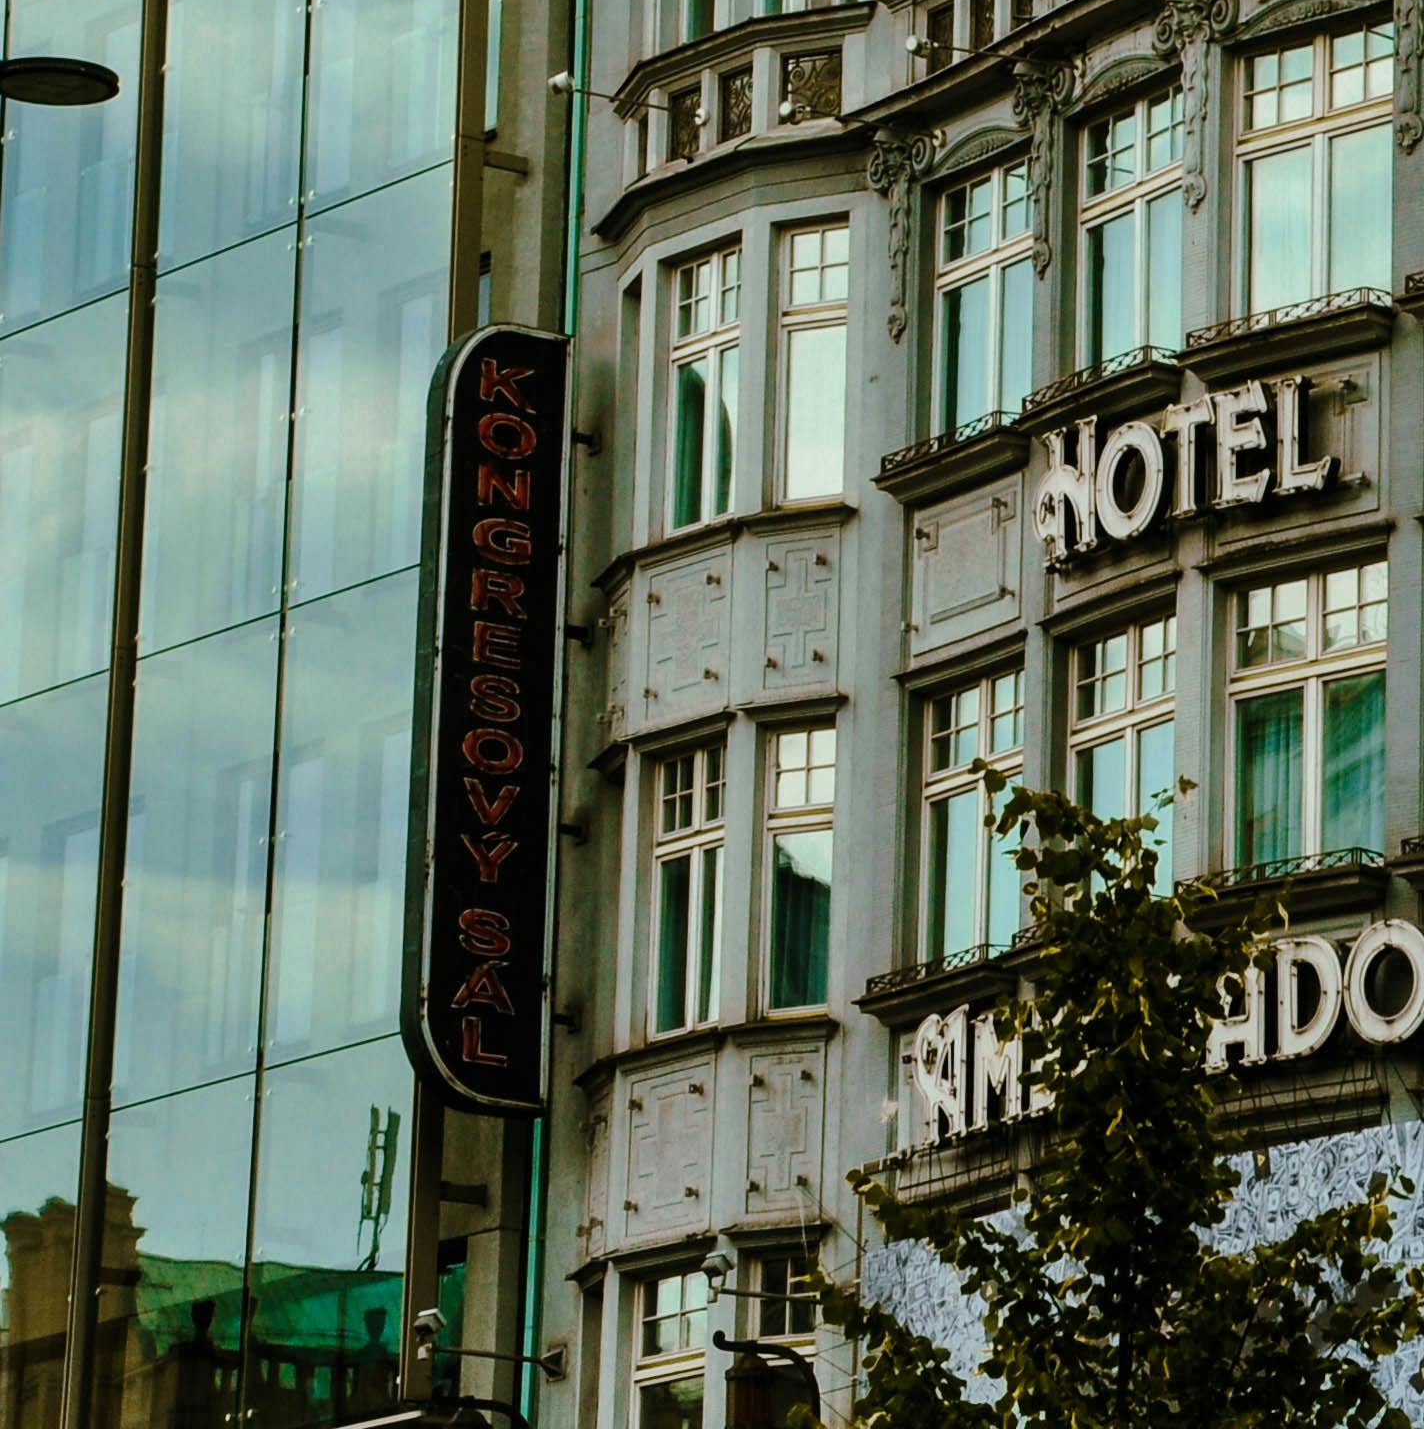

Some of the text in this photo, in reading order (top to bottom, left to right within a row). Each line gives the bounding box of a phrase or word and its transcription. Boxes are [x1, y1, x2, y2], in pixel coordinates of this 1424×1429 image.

[1033, 375, 1340, 575] HOTEL
[452, 357, 537, 1069] KONGRESOVÝ SÁL
